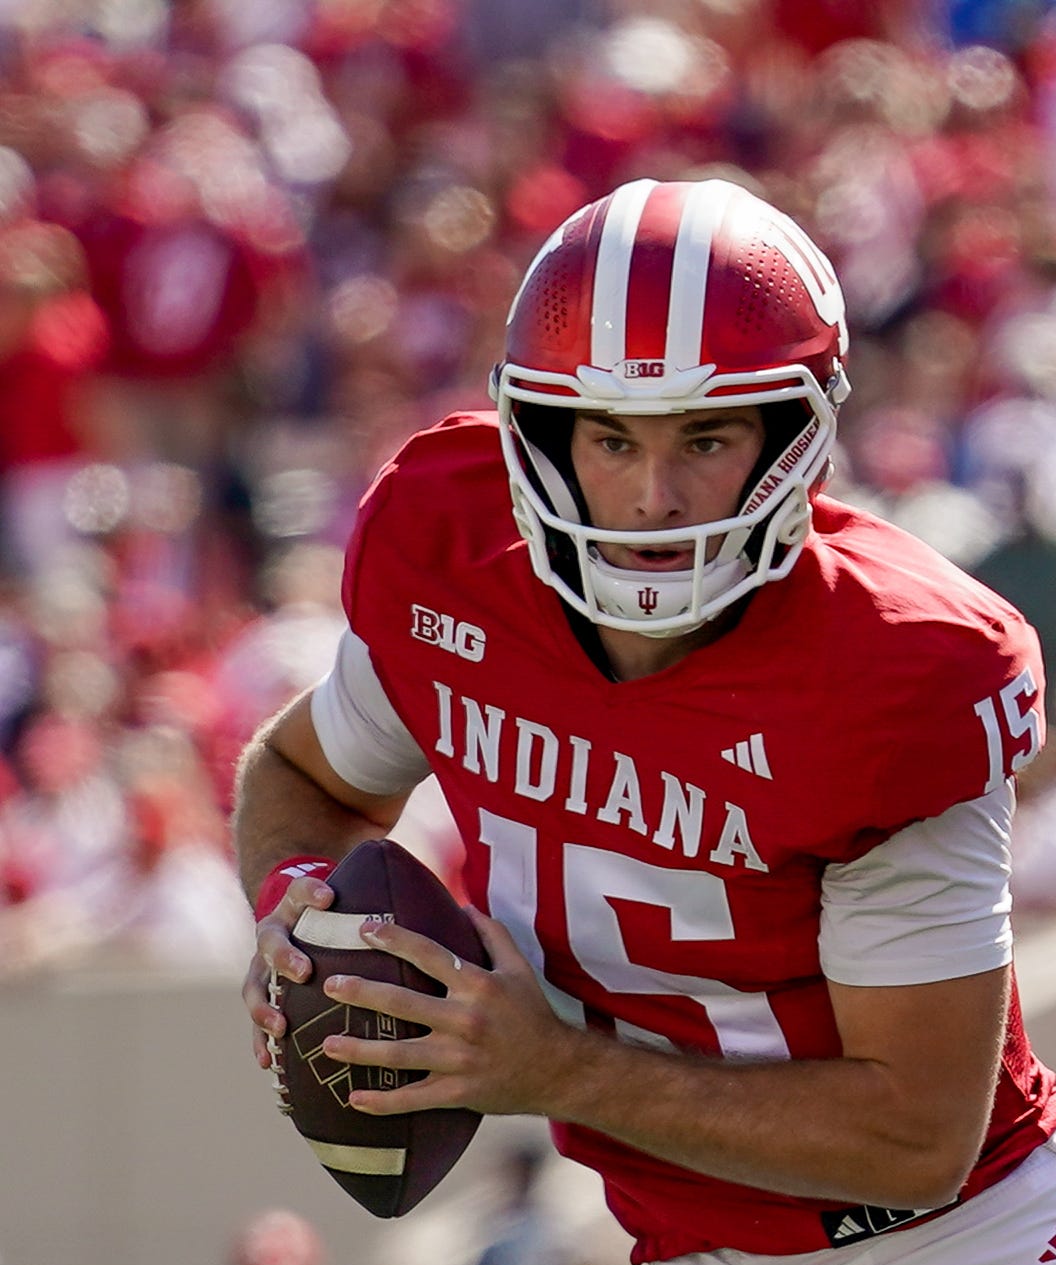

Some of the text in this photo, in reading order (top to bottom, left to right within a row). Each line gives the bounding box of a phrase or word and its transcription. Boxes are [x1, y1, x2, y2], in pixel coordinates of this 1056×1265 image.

[433, 681, 769, 874] INDIANA
[973, 664, 1042, 796] 15
[479, 807, 792, 1062] 15
